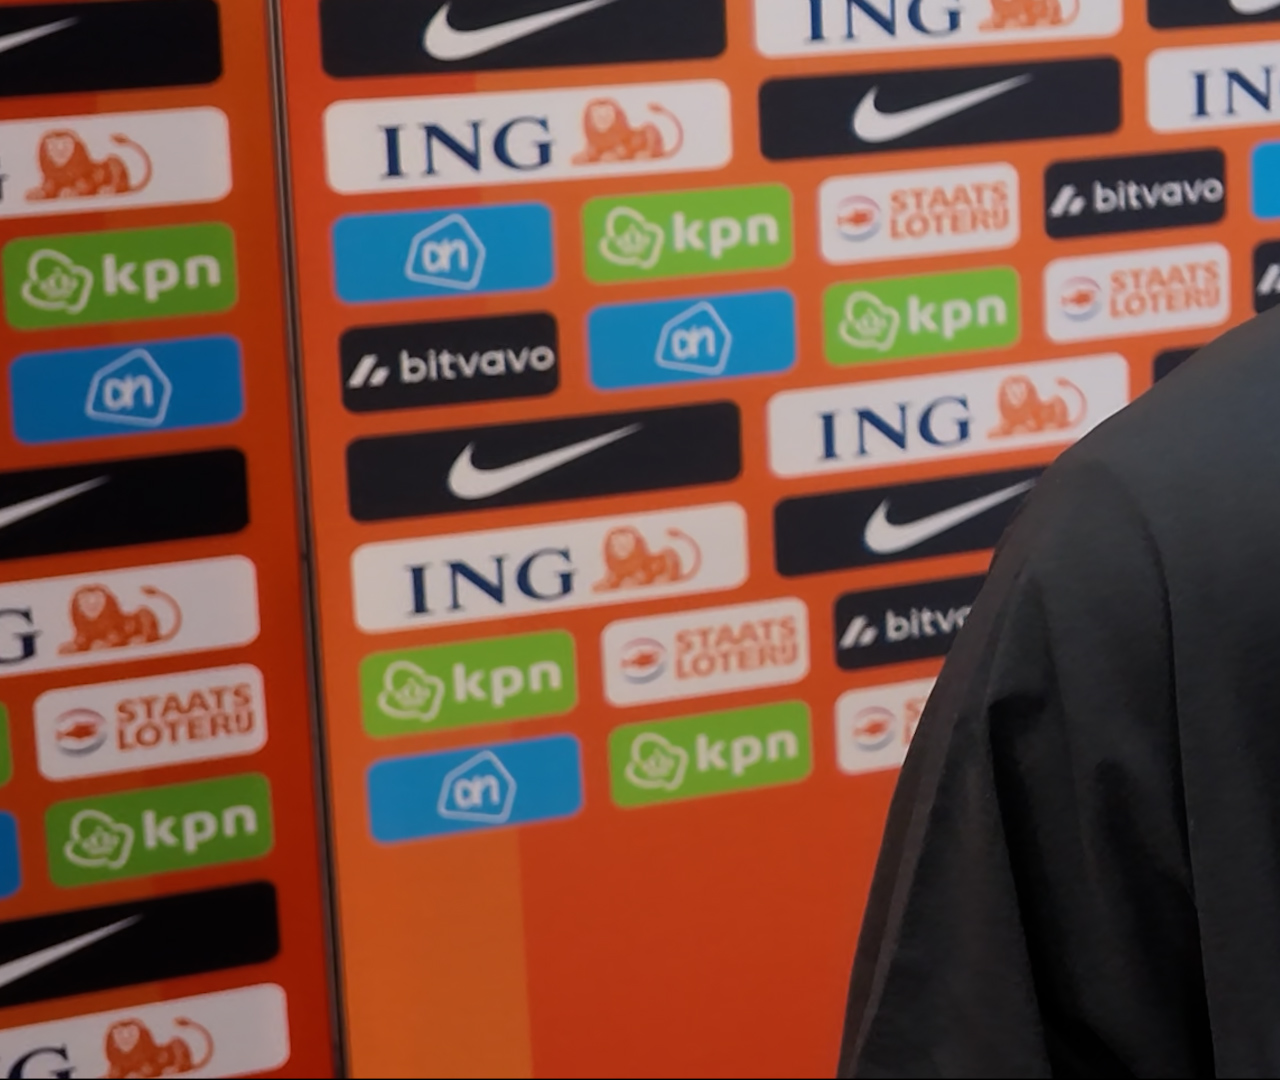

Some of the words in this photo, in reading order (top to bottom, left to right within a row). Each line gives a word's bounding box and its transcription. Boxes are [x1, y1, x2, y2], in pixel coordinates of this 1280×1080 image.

[381, 117, 554, 181] ING
[891, 182, 1009, 211] STAATS
[1094, 179, 1223, 212] bitvavo
[672, 212, 778, 258] kpn
[103, 254, 220, 301] kpn
[1111, 262, 1220, 296] STAATS
[907, 296, 1006, 339] kpn
[401, 346, 554, 382] bitvavo
[818, 395, 970, 461] ING
[406, 547, 575, 616] ING
[675, 617, 799, 649] STAATS
[886, 605, 971, 642] bitv
[117, 683, 254, 723] STAATS
[453, 661, 561, 706] kpn
[696, 731, 798, 775] kpn
[143, 806, 256, 852] kpn
